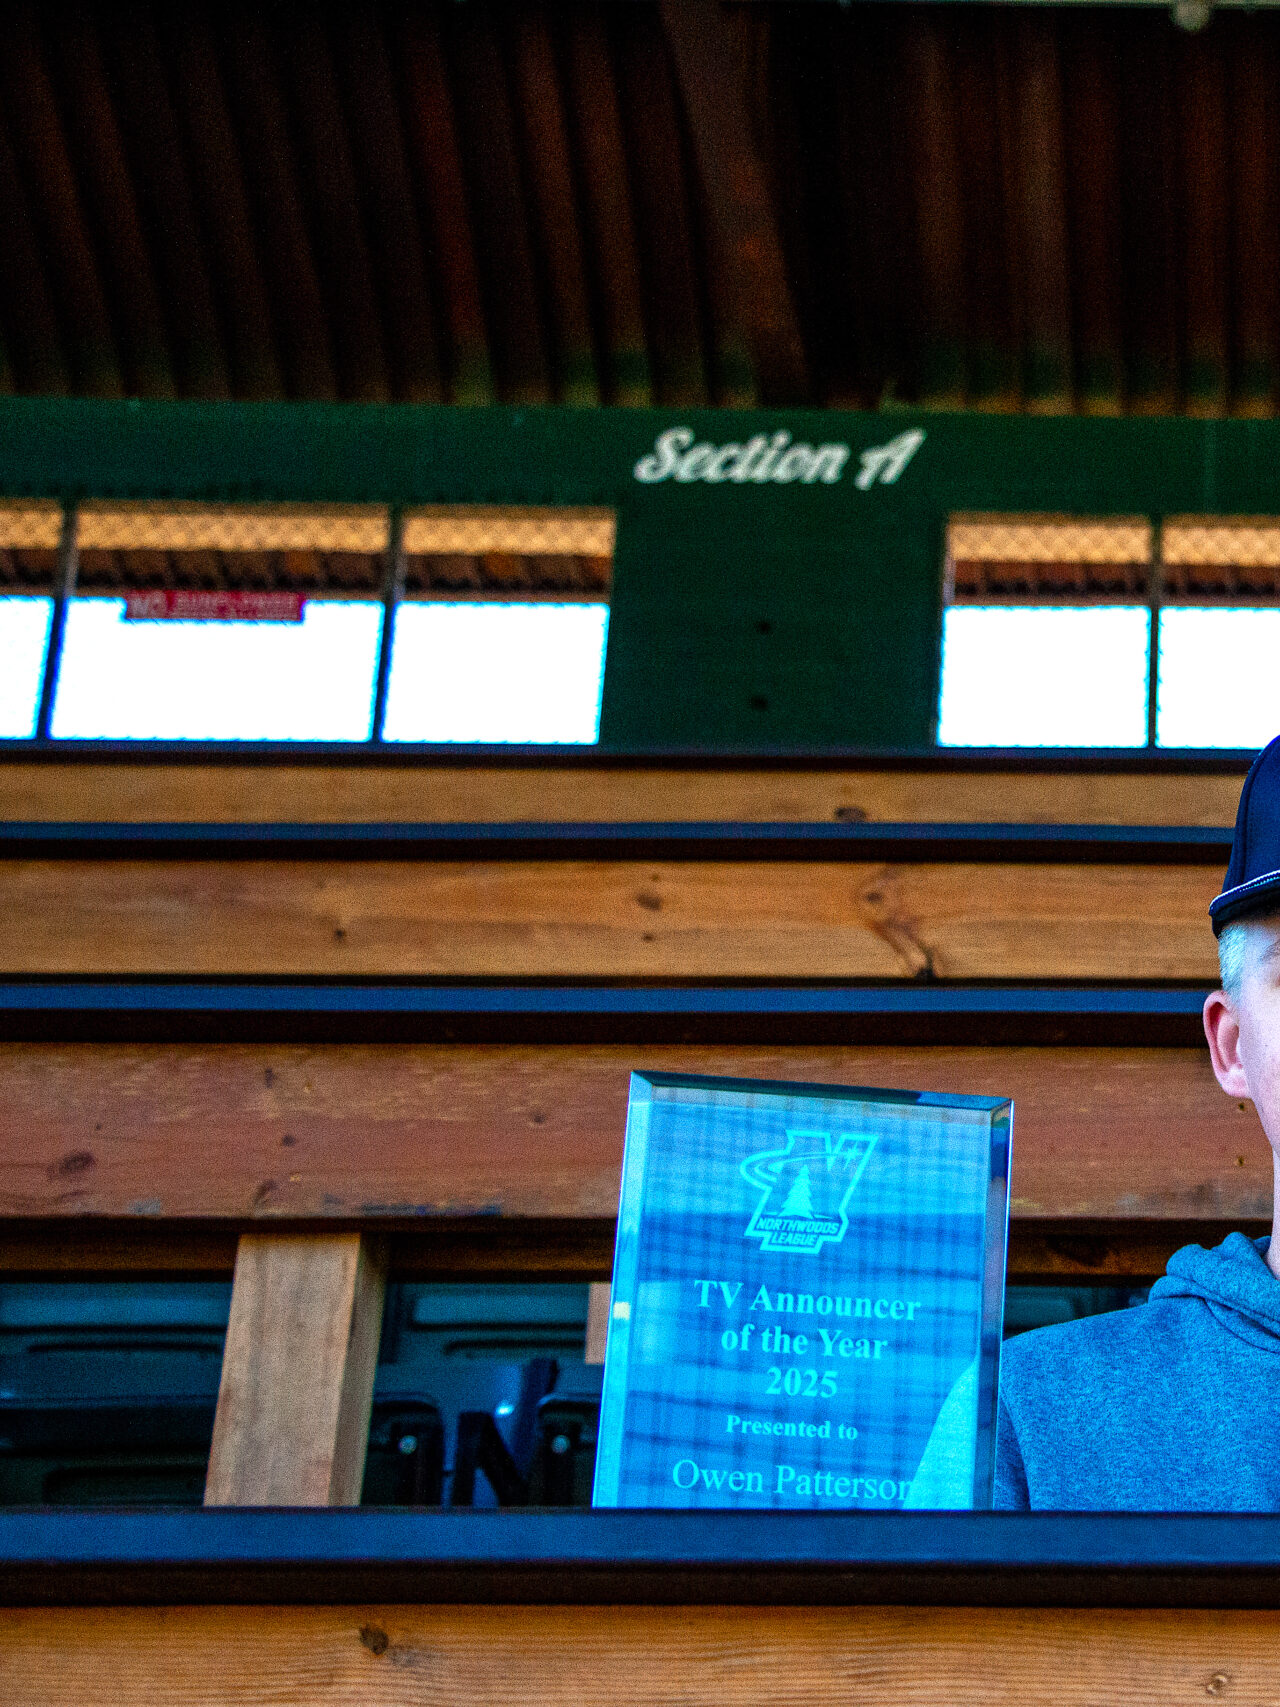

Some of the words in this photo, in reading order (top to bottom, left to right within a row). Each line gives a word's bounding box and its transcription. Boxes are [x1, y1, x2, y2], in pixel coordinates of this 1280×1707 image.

[632, 425, 849, 484] Section
[855, 427, 927, 491] A
[756, 1217, 840, 1235] NORTHWOODS
[771, 1232, 819, 1246] LEAGUE
[694, 1279, 744, 1309] TV
[750, 1284, 921, 1321] Announcer
[721, 1323, 755, 1351] of
[761, 1326, 808, 1355] the
[818, 1328, 888, 1360] Year
[765, 1366, 839, 1398] 2025
[725, 1414, 831, 1439] Presented
[838, 1422, 858, 1440] to
[672, 1459, 764, 1493] Owen
